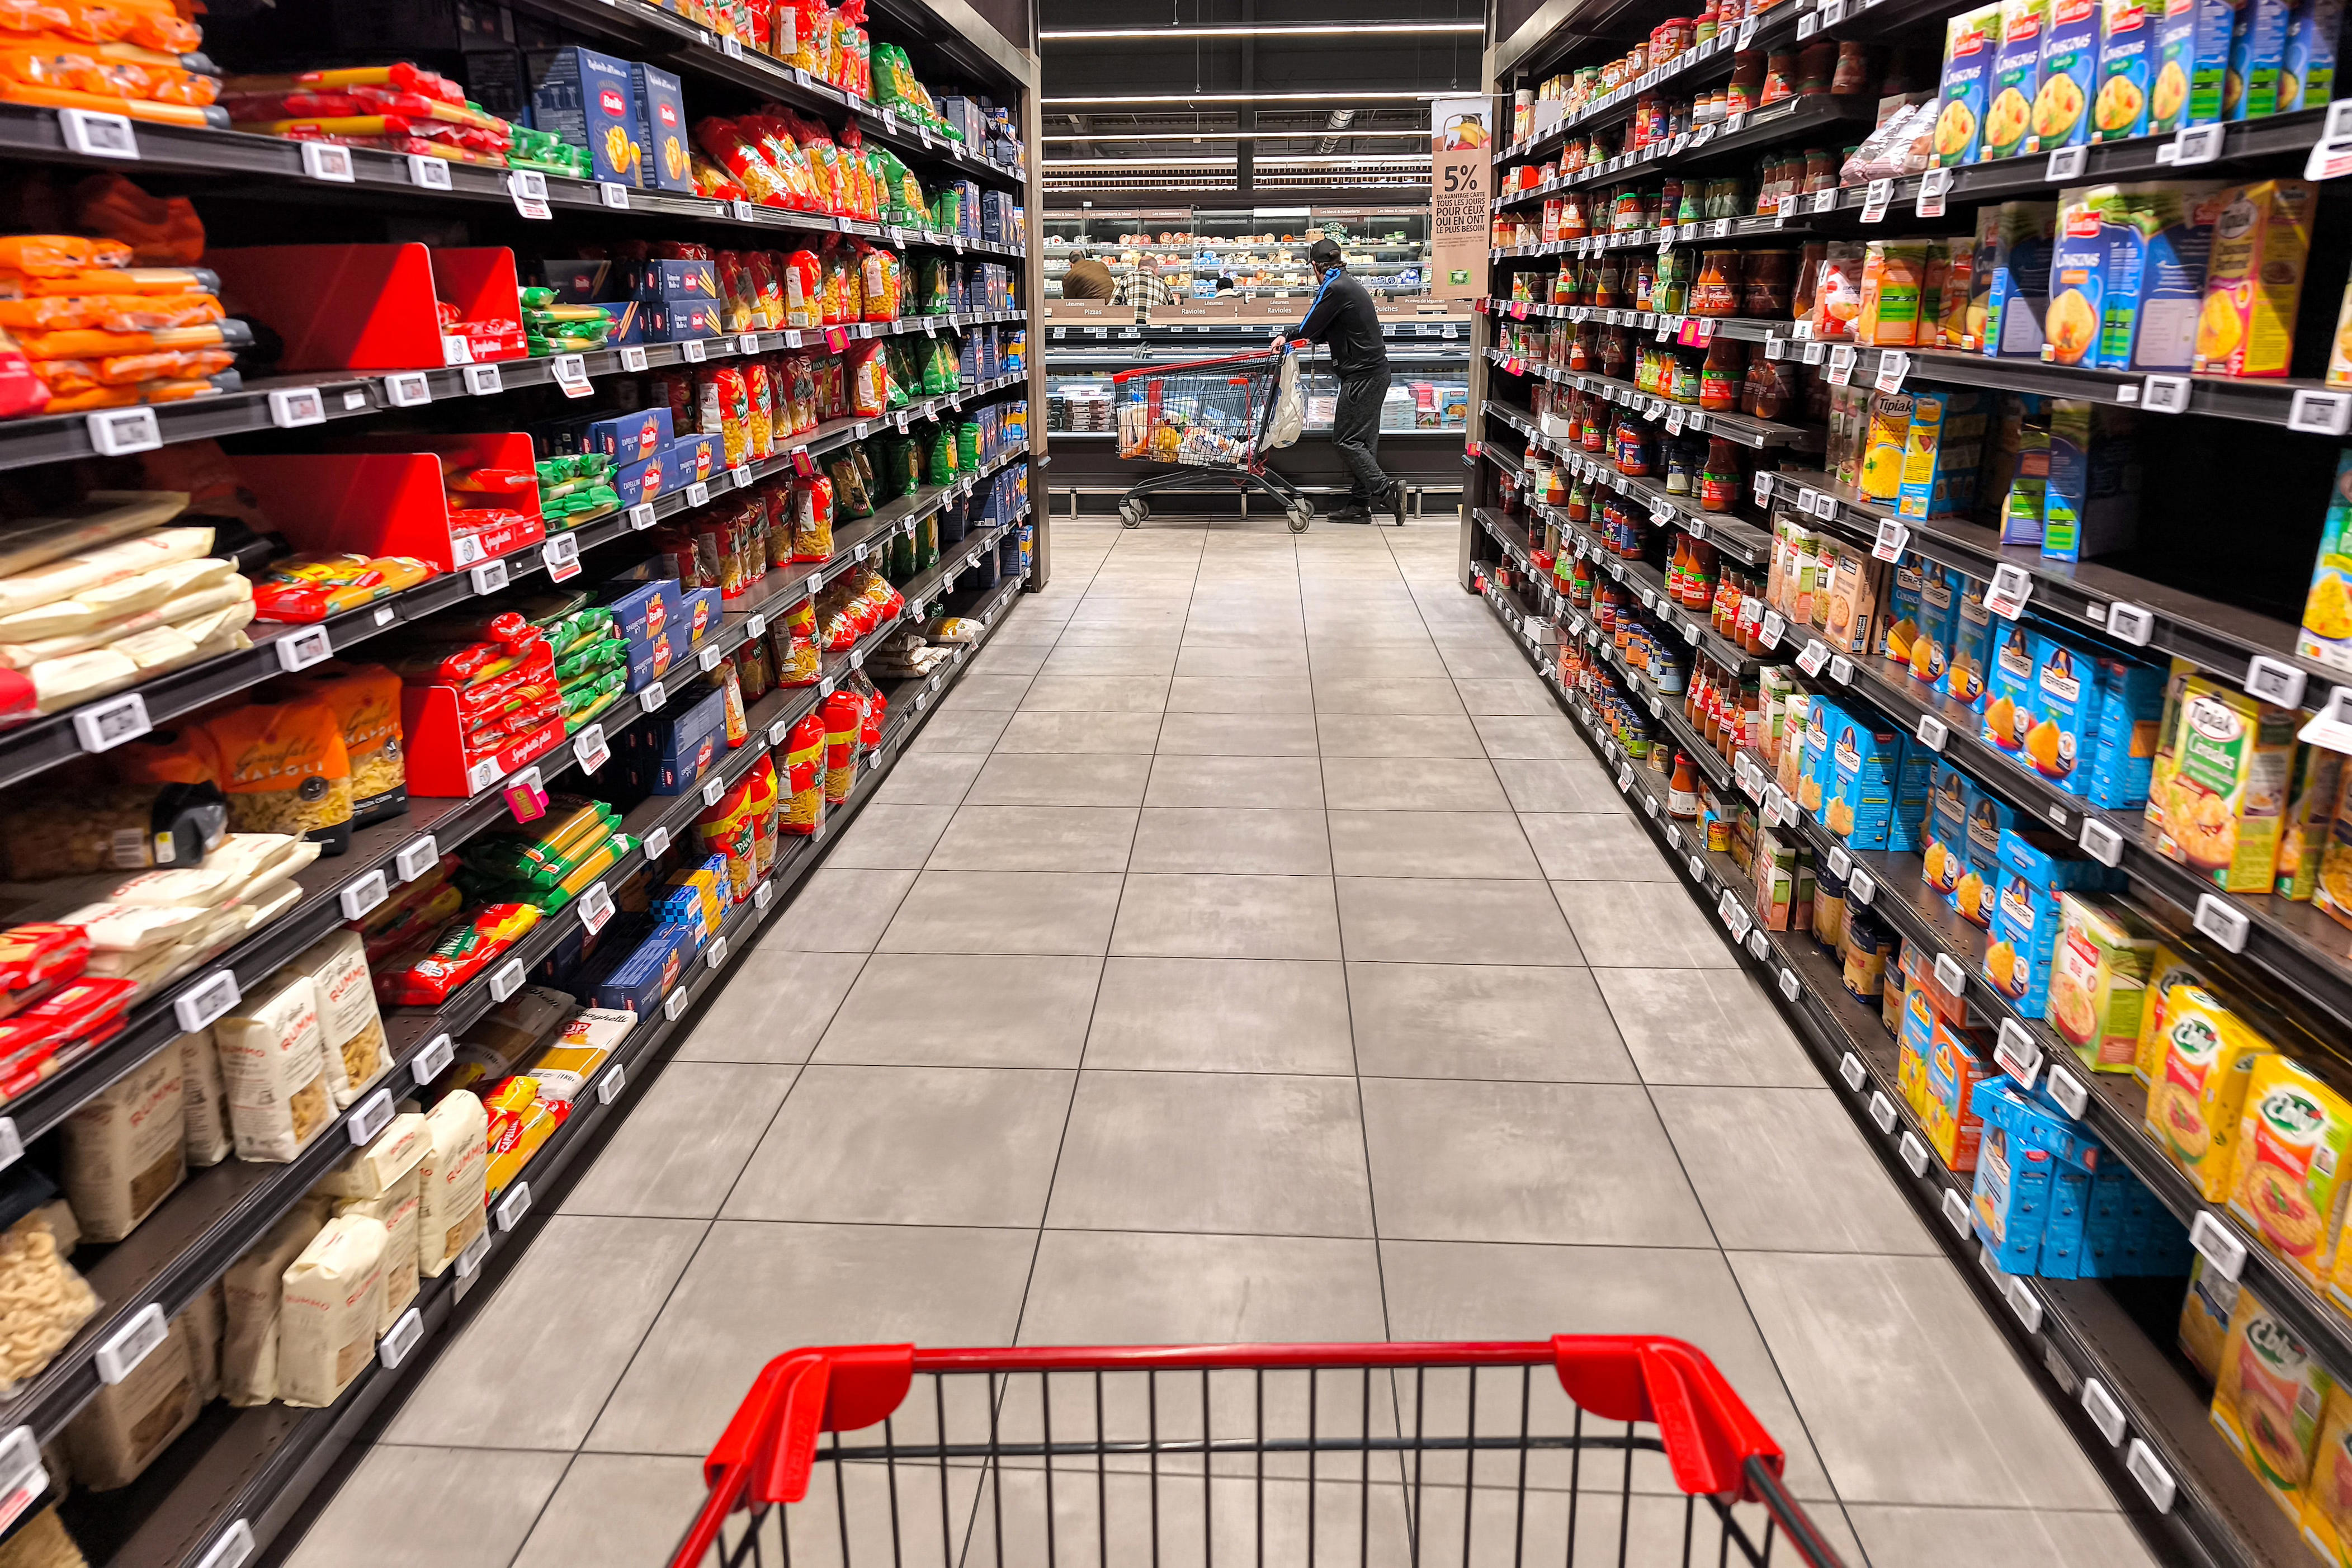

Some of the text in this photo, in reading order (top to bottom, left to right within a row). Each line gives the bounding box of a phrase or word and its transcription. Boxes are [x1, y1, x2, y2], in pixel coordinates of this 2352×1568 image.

[1444, 164, 1477, 191] 5%
[1437, 205, 1484, 217] POUR CEUX
[1436, 214, 1484, 226] QUI EN ONT
[1879, 398, 1912, 414] Tipiak
[642, 429, 657, 444] Barilla
[698, 454, 710, 467] Barilla
[645, 471, 660, 486] Barilla
[649, 607, 664, 624] Barilla
[694, 613, 707, 628] Barilla
[655, 647, 669, 664] Barilla
[329, 965, 365, 1003] RUMMO
[447, 1139, 486, 1185] RUMMO
